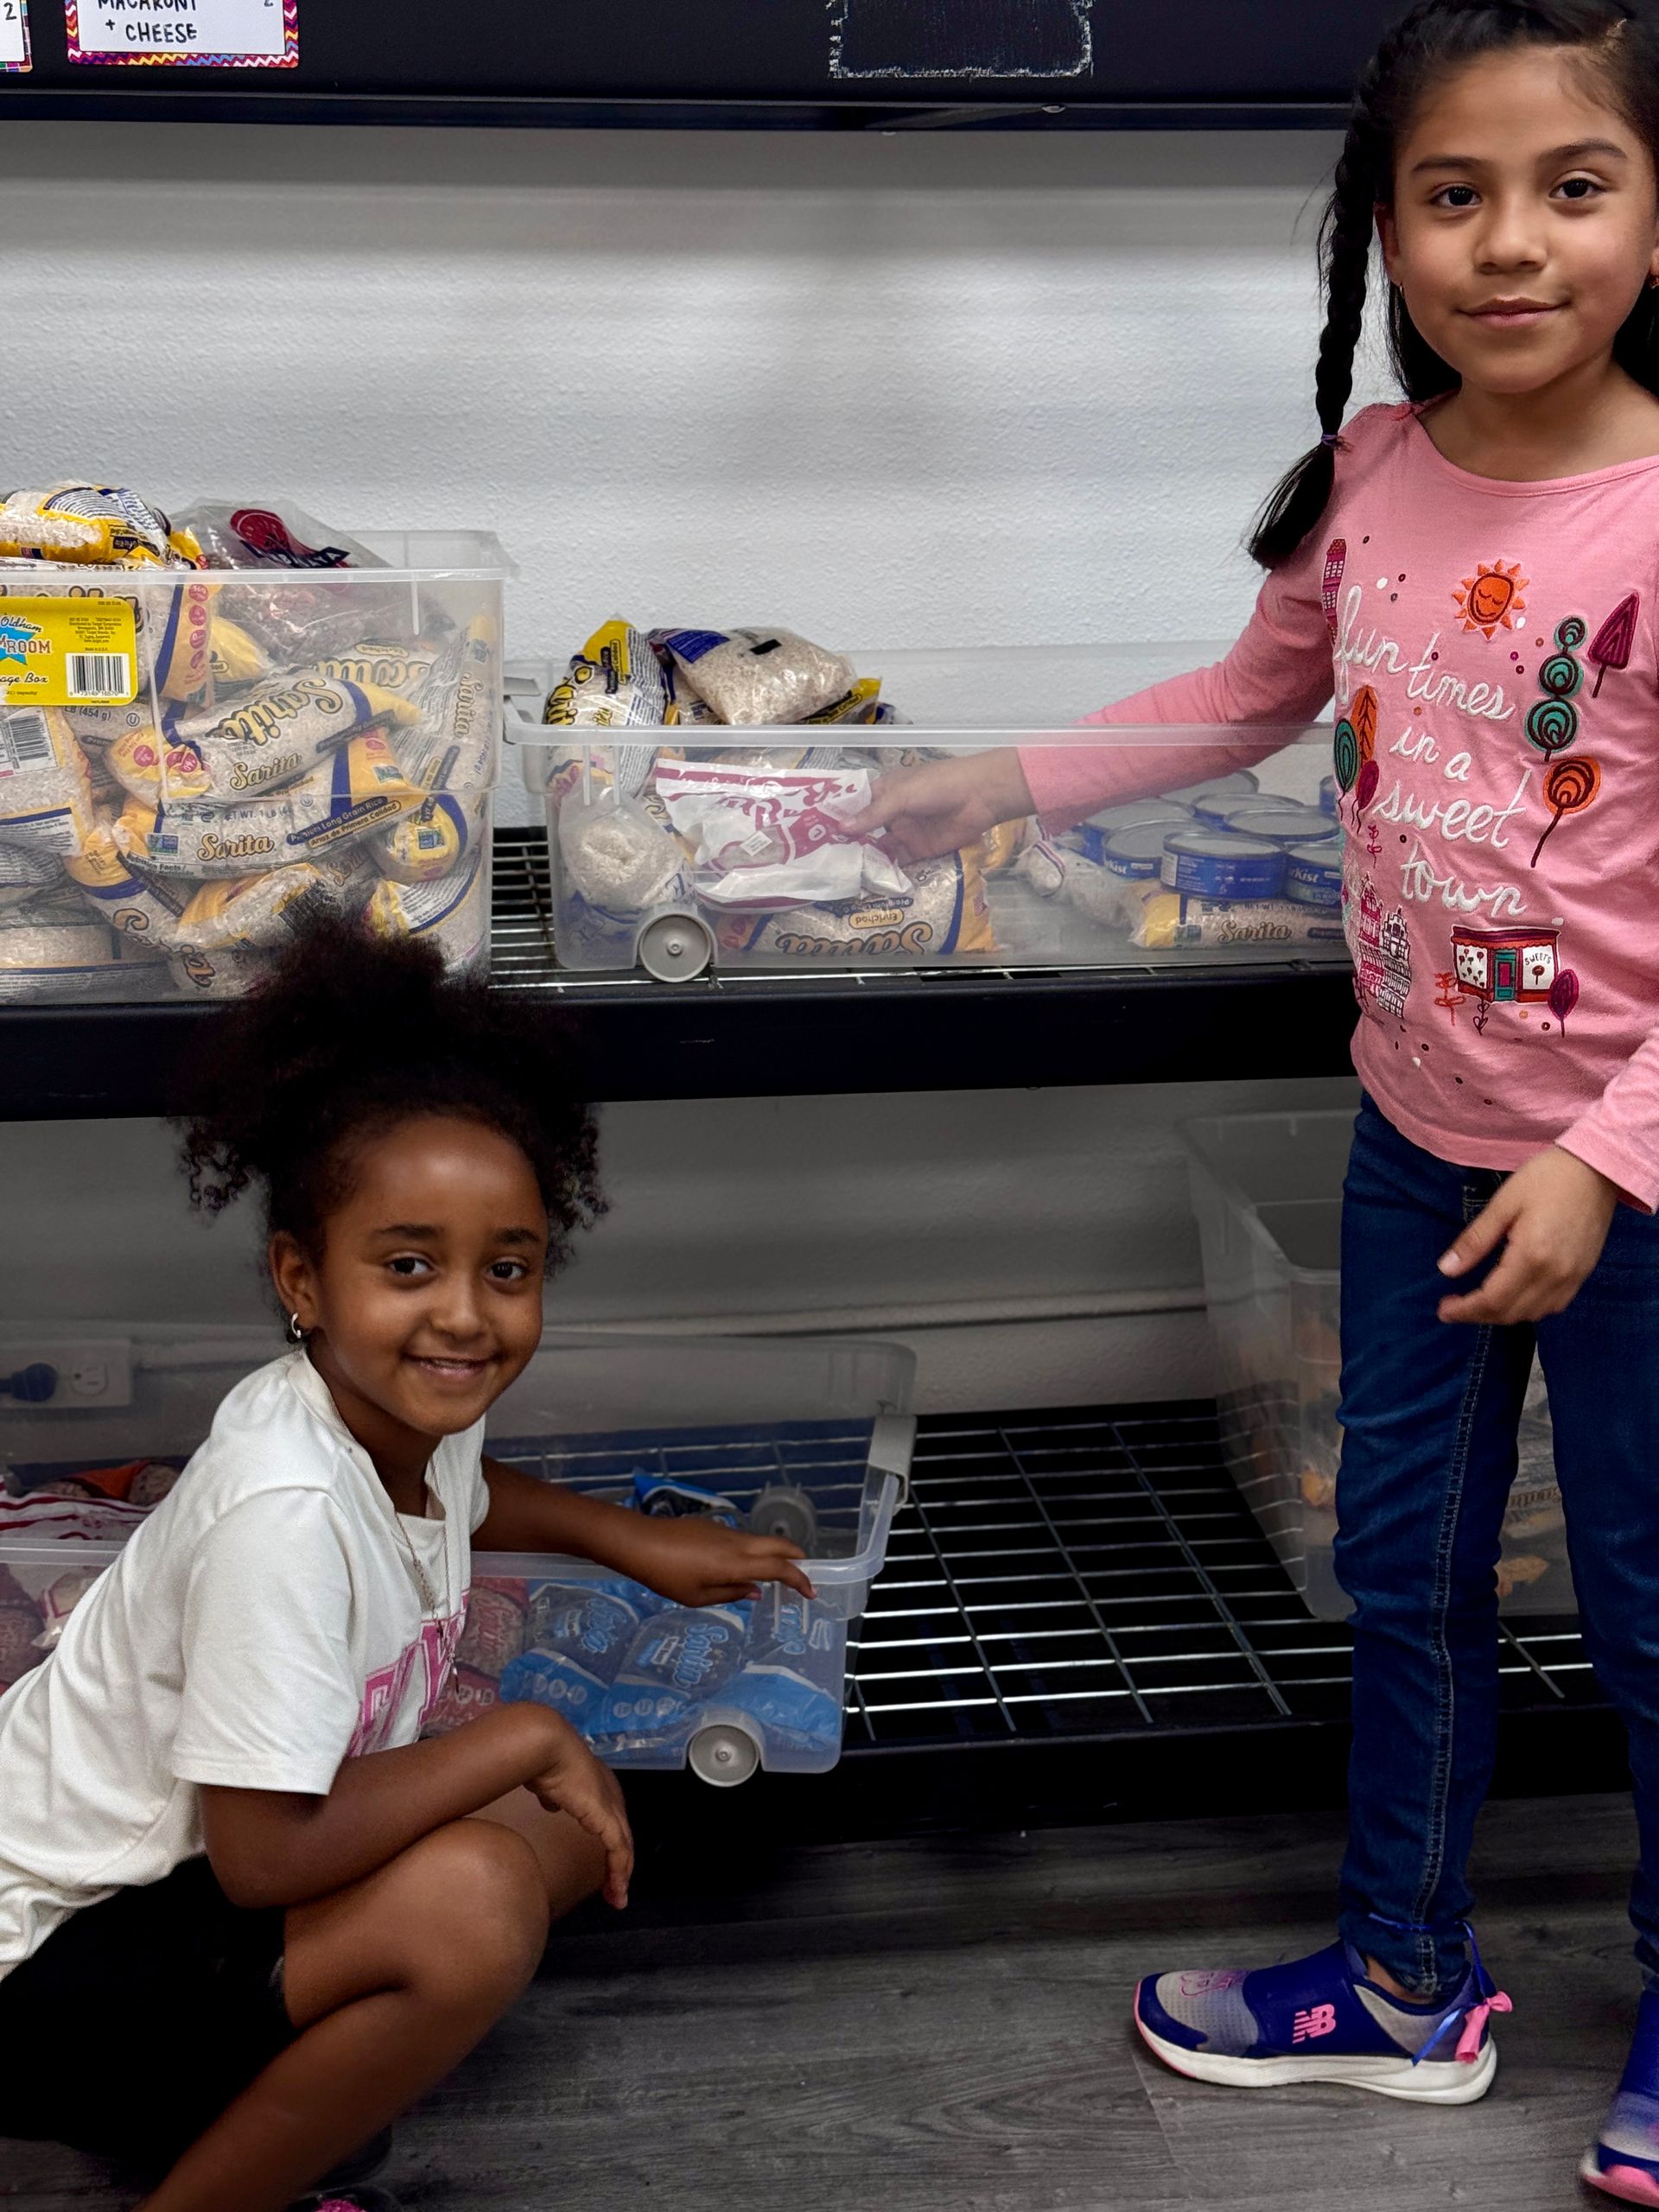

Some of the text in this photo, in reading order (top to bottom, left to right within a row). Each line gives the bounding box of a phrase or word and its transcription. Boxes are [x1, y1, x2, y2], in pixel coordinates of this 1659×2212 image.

[4, 2, 17, 21] 2
[125, 22, 197, 43] CHEESE
[1, 614, 42, 632] Oldham
[6, 639, 51, 654] ROOM
[24, 672, 48, 683] Box
[1408, 632, 1513, 721] times
[79, 707, 99, 719] (454
[101, 710, 111, 721] g)
[1389, 723, 1472, 781] in a
[230, 753, 302, 791] Sarita
[224, 810, 238, 821] ET
[321, 817, 342, 830] Long
[343, 806, 365, 820] Grain
[369, 802, 397, 820] Calidad
[1376, 768, 1531, 849] sweet
[197, 832, 275, 861] Sarita
[1401, 841, 1527, 917] town
[855, 913, 898, 925] Enriched
[1217, 918, 1293, 944] Sarita
[1524, 952, 1552, 966] SWEETS
